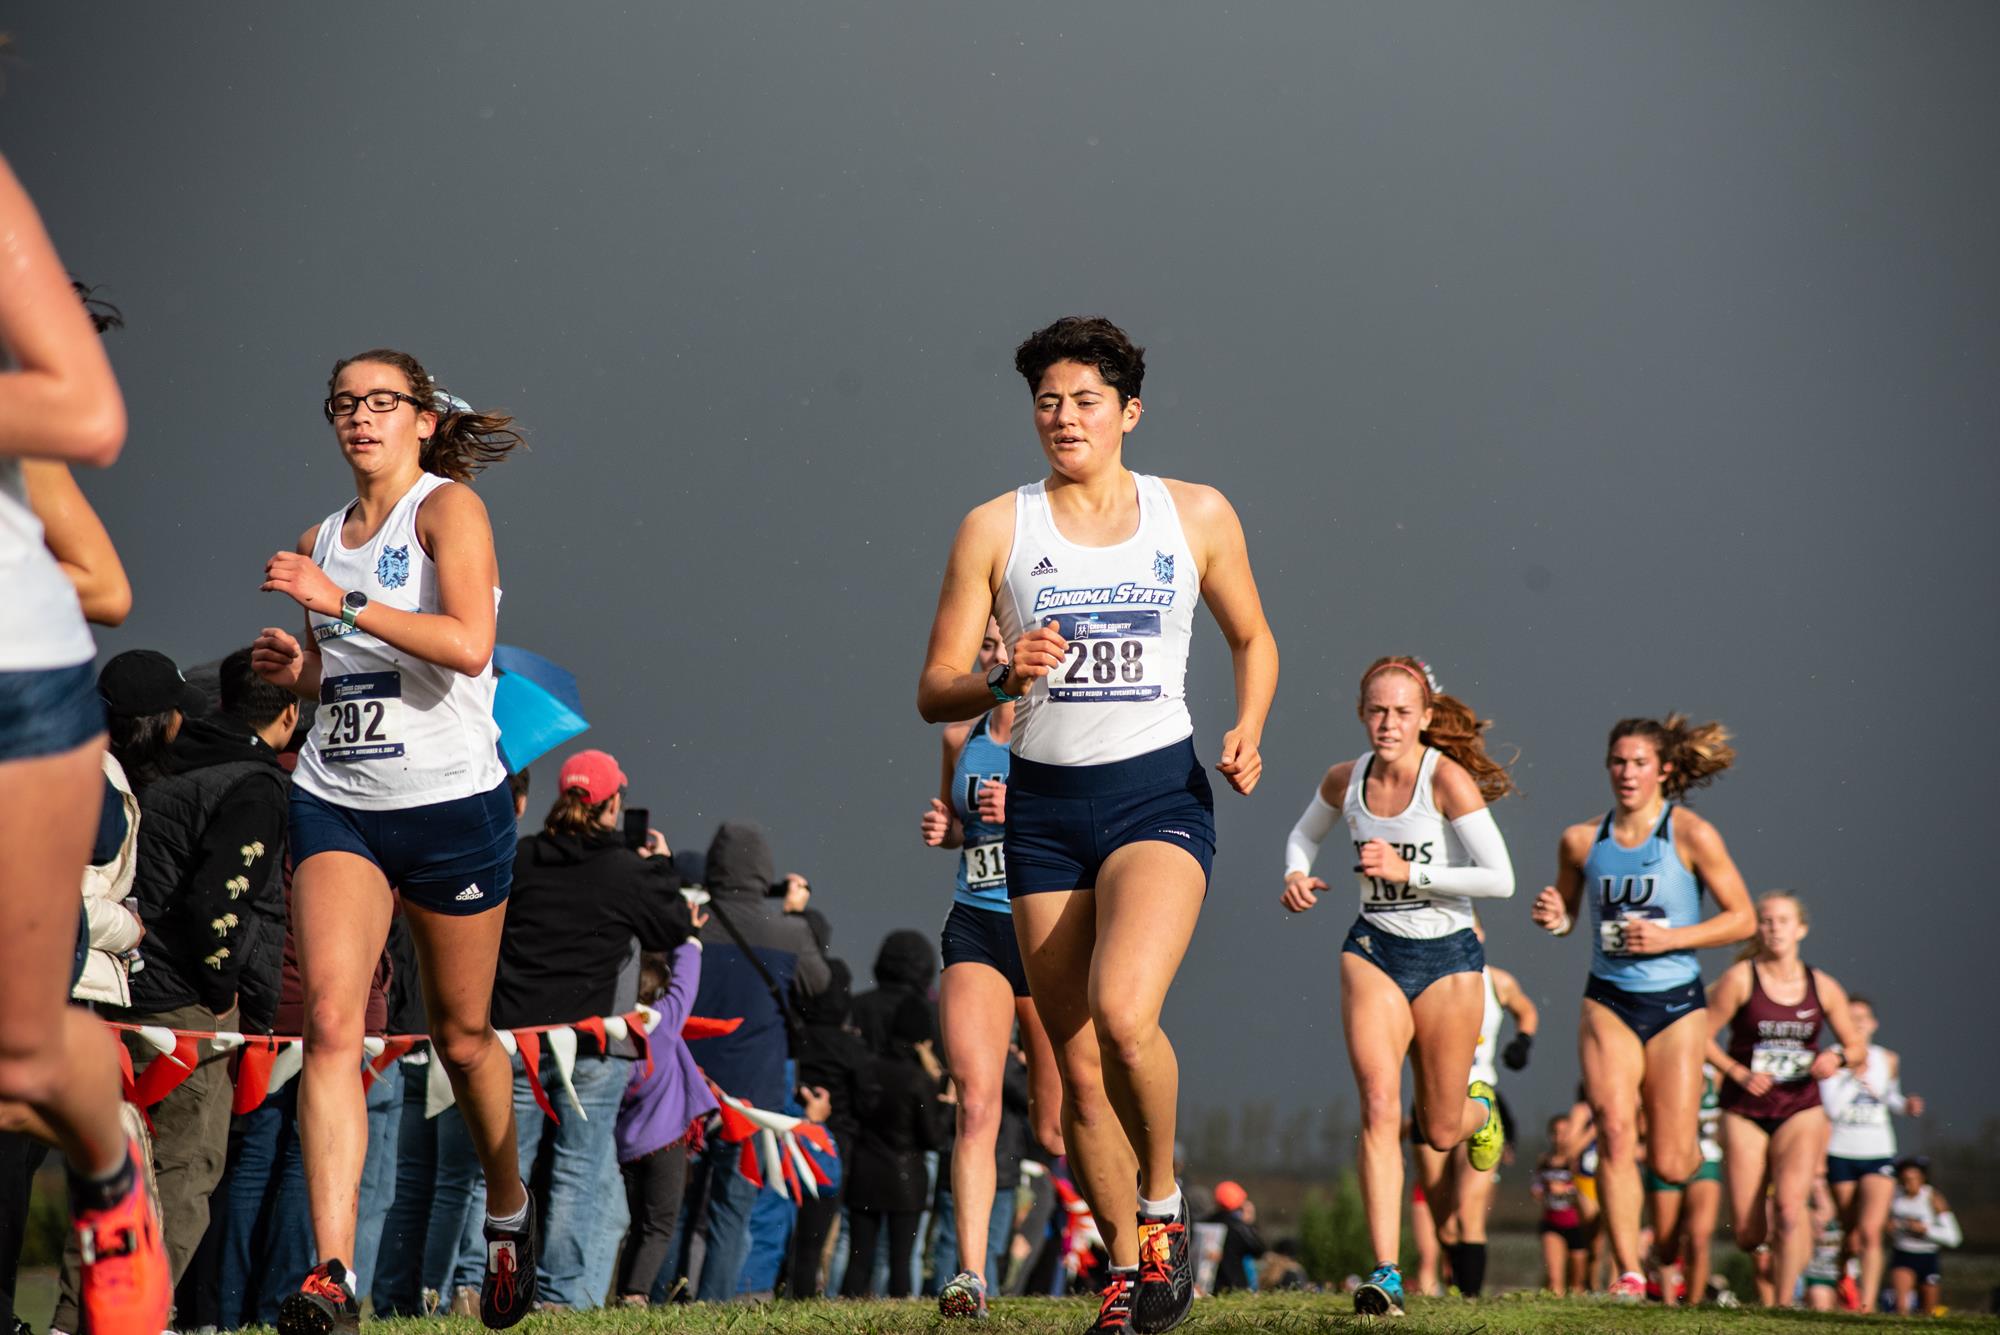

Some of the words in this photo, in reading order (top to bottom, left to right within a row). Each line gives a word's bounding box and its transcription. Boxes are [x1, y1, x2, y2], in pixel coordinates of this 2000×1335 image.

[1030, 566, 1058, 577] adidas
[1064, 640, 1144, 684] 288
[328, 700, 386, 745] 292
[975, 846, 1004, 878] 31
[456, 891, 484, 901] adidas
[1598, 875, 1660, 906] W
